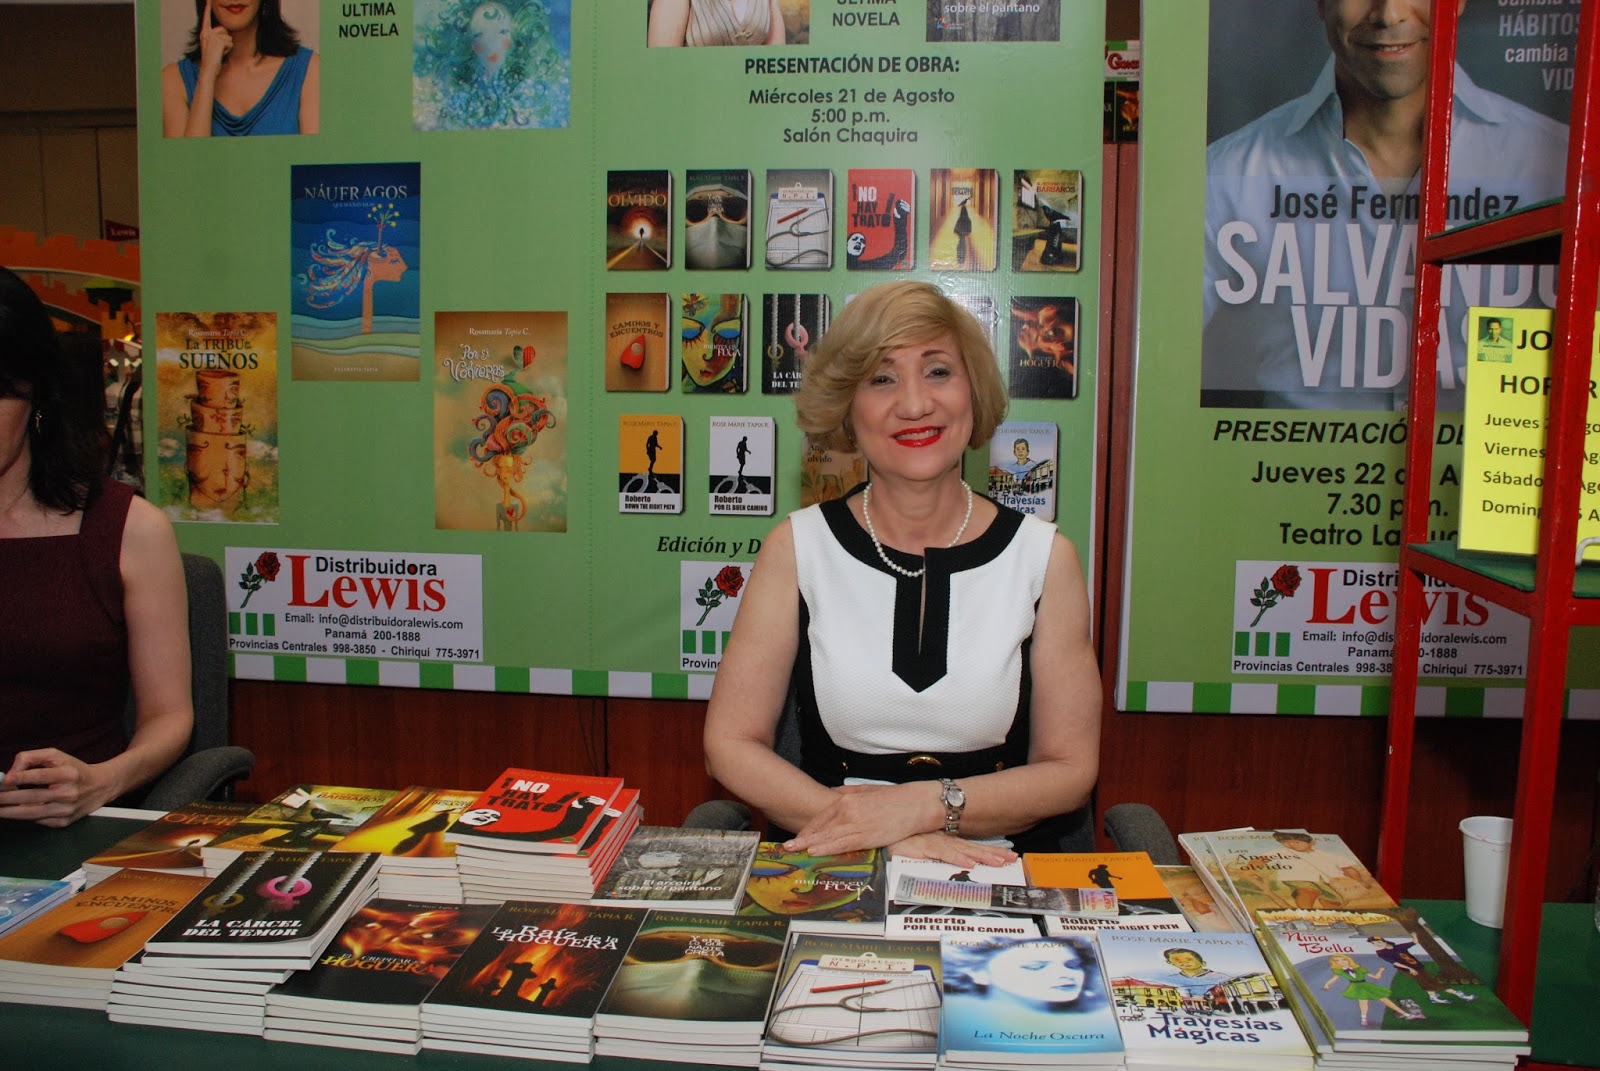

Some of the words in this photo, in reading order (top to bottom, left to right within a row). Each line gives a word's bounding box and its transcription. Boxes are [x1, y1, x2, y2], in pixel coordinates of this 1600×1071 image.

[342, 2, 396, 17] ULTIMA
[944, 3, 977, 13] sobre
[979, 3, 989, 13] el
[991, 3, 1041, 15] pantano
[832, 12, 900, 27] NOVELA
[1498, 9, 1579, 37] HÁBITO
[338, 23, 399, 38] NOVELA
[1505, 43, 1568, 63] cambia
[745, 54, 873, 74] PRESENTACIÓN
[878, 57, 901, 73] DE
[905, 56, 960, 73] OBRA:
[749, 88, 833, 104] Miércoles
[838, 88, 856, 103] 21
[864, 89, 887, 103] de
[893, 88, 955, 106] Agosto
[811, 108, 847, 123] 5:00
[852, 111, 890, 126] p.m.
[783, 127, 831, 143] Salón
[836, 128, 918, 146] Chaquira
[608, 194, 667, 207] OLVIDO
[857, 202, 878, 214] HAY
[1270, 185, 1338, 219] José
[1351, 186, 1520, 220] Fernndez
[610, 328, 664, 338] ENCUENTROS
[612, 321, 651, 331] CAMINOS
[185, 339, 199, 350] La
[202, 339, 244, 350] TRIBU
[460, 344, 478, 360] Por
[179, 350, 259, 369] SUEÑOS
[717, 349, 741, 357] FUGA
[1485, 414, 1540, 429] Jueves
[1213, 419, 1408, 444] PRESENTACIÓ
[1484, 442, 1546, 459] Viernes
[1251, 461, 1346, 485] Jueves
[1354, 463, 1385, 485] 22
[1483, 470, 1544, 488] Sábado
[625, 495, 652, 503] Roberto
[714, 495, 743, 503] Roberto
[1003, 495, 1046, 505] Travesías
[1327, 493, 1381, 516] 7.30
[1279, 523, 1362, 546] Teatro
[657, 536, 726, 553] Edición
[729, 542, 743, 557] y
[315, 556, 437, 576] Distribuidora
[285, 555, 446, 612] Lewis
[285, 613, 315, 624] Email:
[319, 613, 463, 630] info@distribuidoralewis.com
[325, 628, 367, 641] Panamá
[373, 630, 421, 642] 200-1888
[1302, 631, 1337, 643] Email:
[229, 638, 279, 651] Provincias
[282, 641, 328, 653] Centrales
[333, 643, 376, 655] 998-3850
[391, 646, 431, 658] Chiriquí
[436, 648, 480, 659] 775-3971
[1233, 660, 1293, 672] Provincias
[1296, 661, 1349, 673] Centrales
[1422, 664, 1467, 676] Chiriquí
[1474, 664, 1523, 676] 775-3971
[501, 789, 545, 801] HAY
[1240, 863, 1293, 871] olvido
[669, 885, 722, 893] pantano
[824, 883, 875, 901] FUGA
[91, 895, 178, 907] CAMINOS
[195, 919, 221, 928] LA
[226, 918, 303, 929] CÁRCEL
[588, 912, 621, 920] TAPIA
[691, 917, 731, 926] MARIE
[903, 916, 967, 925] Roberto
[182, 928, 221, 937] DEL
[228, 928, 300, 937] TEMOR
[491, 926, 513, 935] La
[519, 924, 579, 941] Raíz
[978, 926, 1025, 934] CAMINO
[1282, 931, 1329, 942] Niña
[496, 931, 619, 950] HOGUERA
[841, 943, 879, 951] MARIE
[1298, 943, 1355, 954] Bella
[320, 956, 435, 975] HOGUERA
[974, 1030, 993, 1039] La
[1000, 1031, 1047, 1041] Noche
[1050, 1032, 1105, 1041] Oscura
[1146, 1023, 1261, 1045] Mágicas
